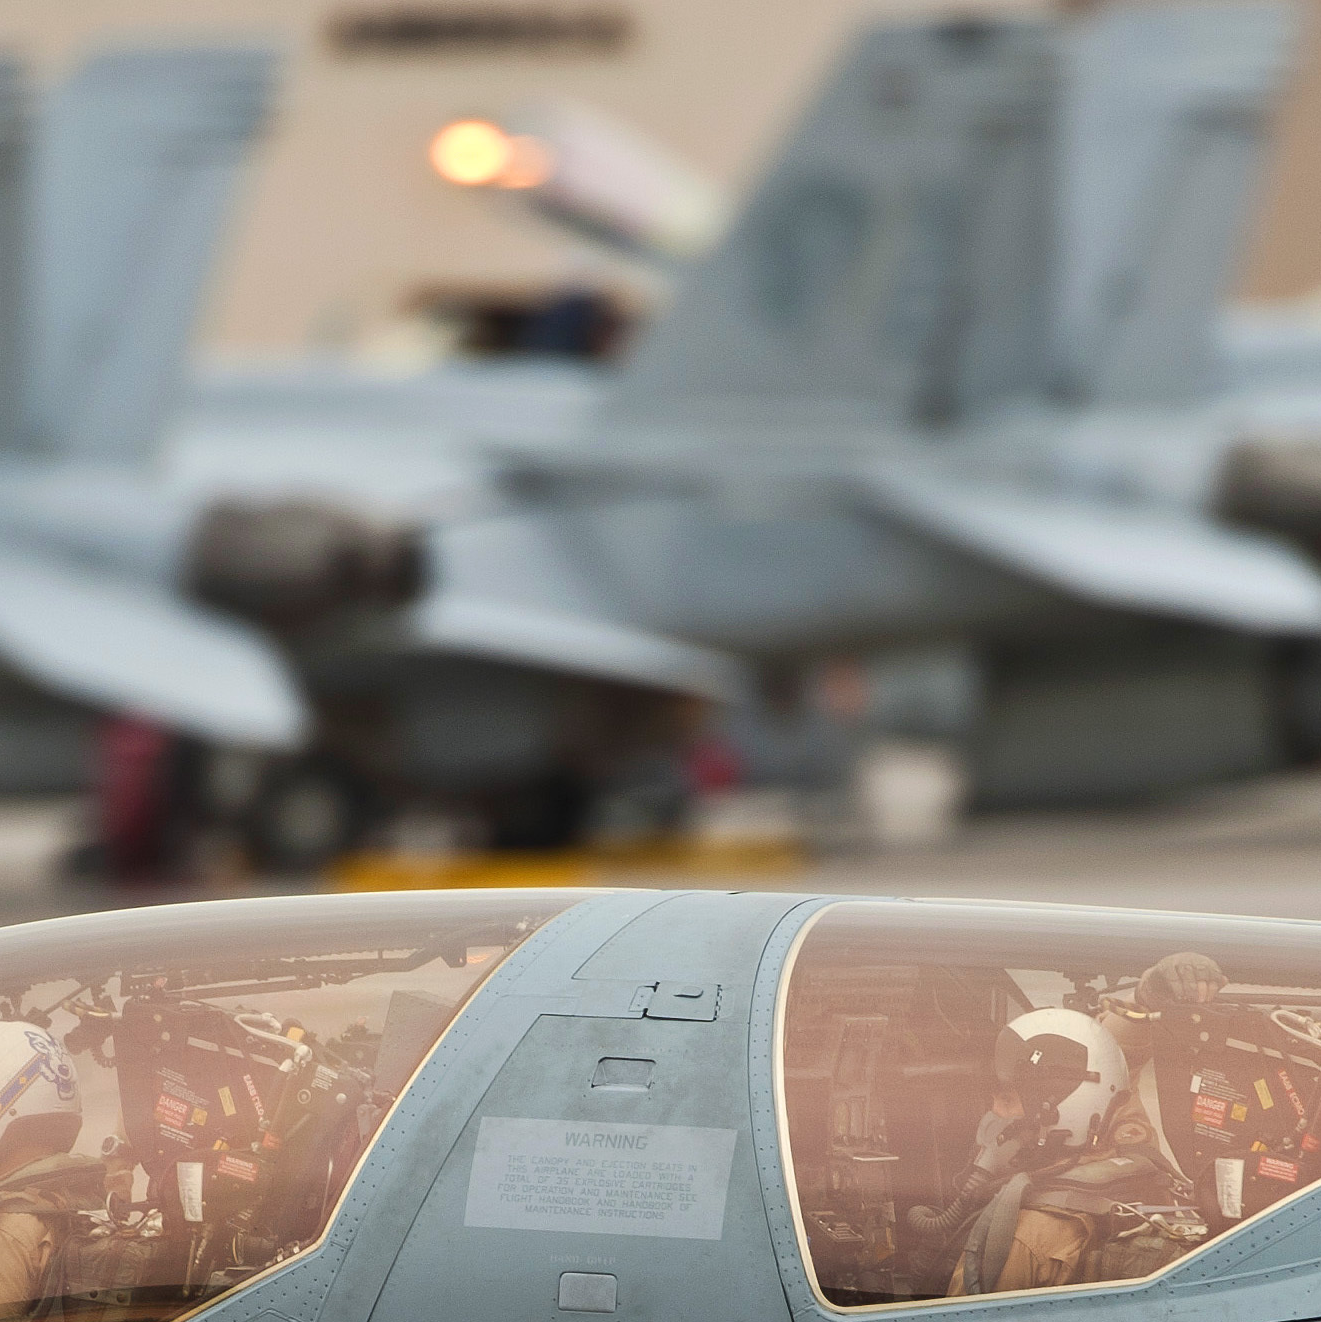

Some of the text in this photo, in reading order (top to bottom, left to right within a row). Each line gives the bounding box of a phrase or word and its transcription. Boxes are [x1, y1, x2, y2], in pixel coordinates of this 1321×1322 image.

[158, 1095, 189, 1114] DANGER
[1196, 1095, 1227, 1111] DANGER
[565, 1131, 649, 1150] WARNING
[508, 1154, 526, 1164] THE
[531, 1155, 569, 1165] CANOPY
[575, 1158, 595, 1168] AND
[601, 1160, 647, 1170] EJECTION
[652, 1162, 684, 1171] SEATS
[507, 1164, 527, 1173] THIS
[533, 1166, 580, 1176] AIRPLANE
[586, 1168, 606, 1178] ARE
[613, 1170, 651, 1180] LOADED
[504, 1174, 530, 1183] TOTAL
[537, 1175, 551, 1183] OF
[575, 1178, 626, 1188] EXPLOSIVE
[632, 1181, 692, 1192] CARTRIDGES
[497, 1183, 697, 1202] FOR OPERATION AND MAINTENANCE SEE
[500, 1193, 692, 1211] FLIGHT HANDBOOK AND HANDBOOK OF
[525, 1204, 665, 1220] MAINTENANCE INSTRUCTIONS
